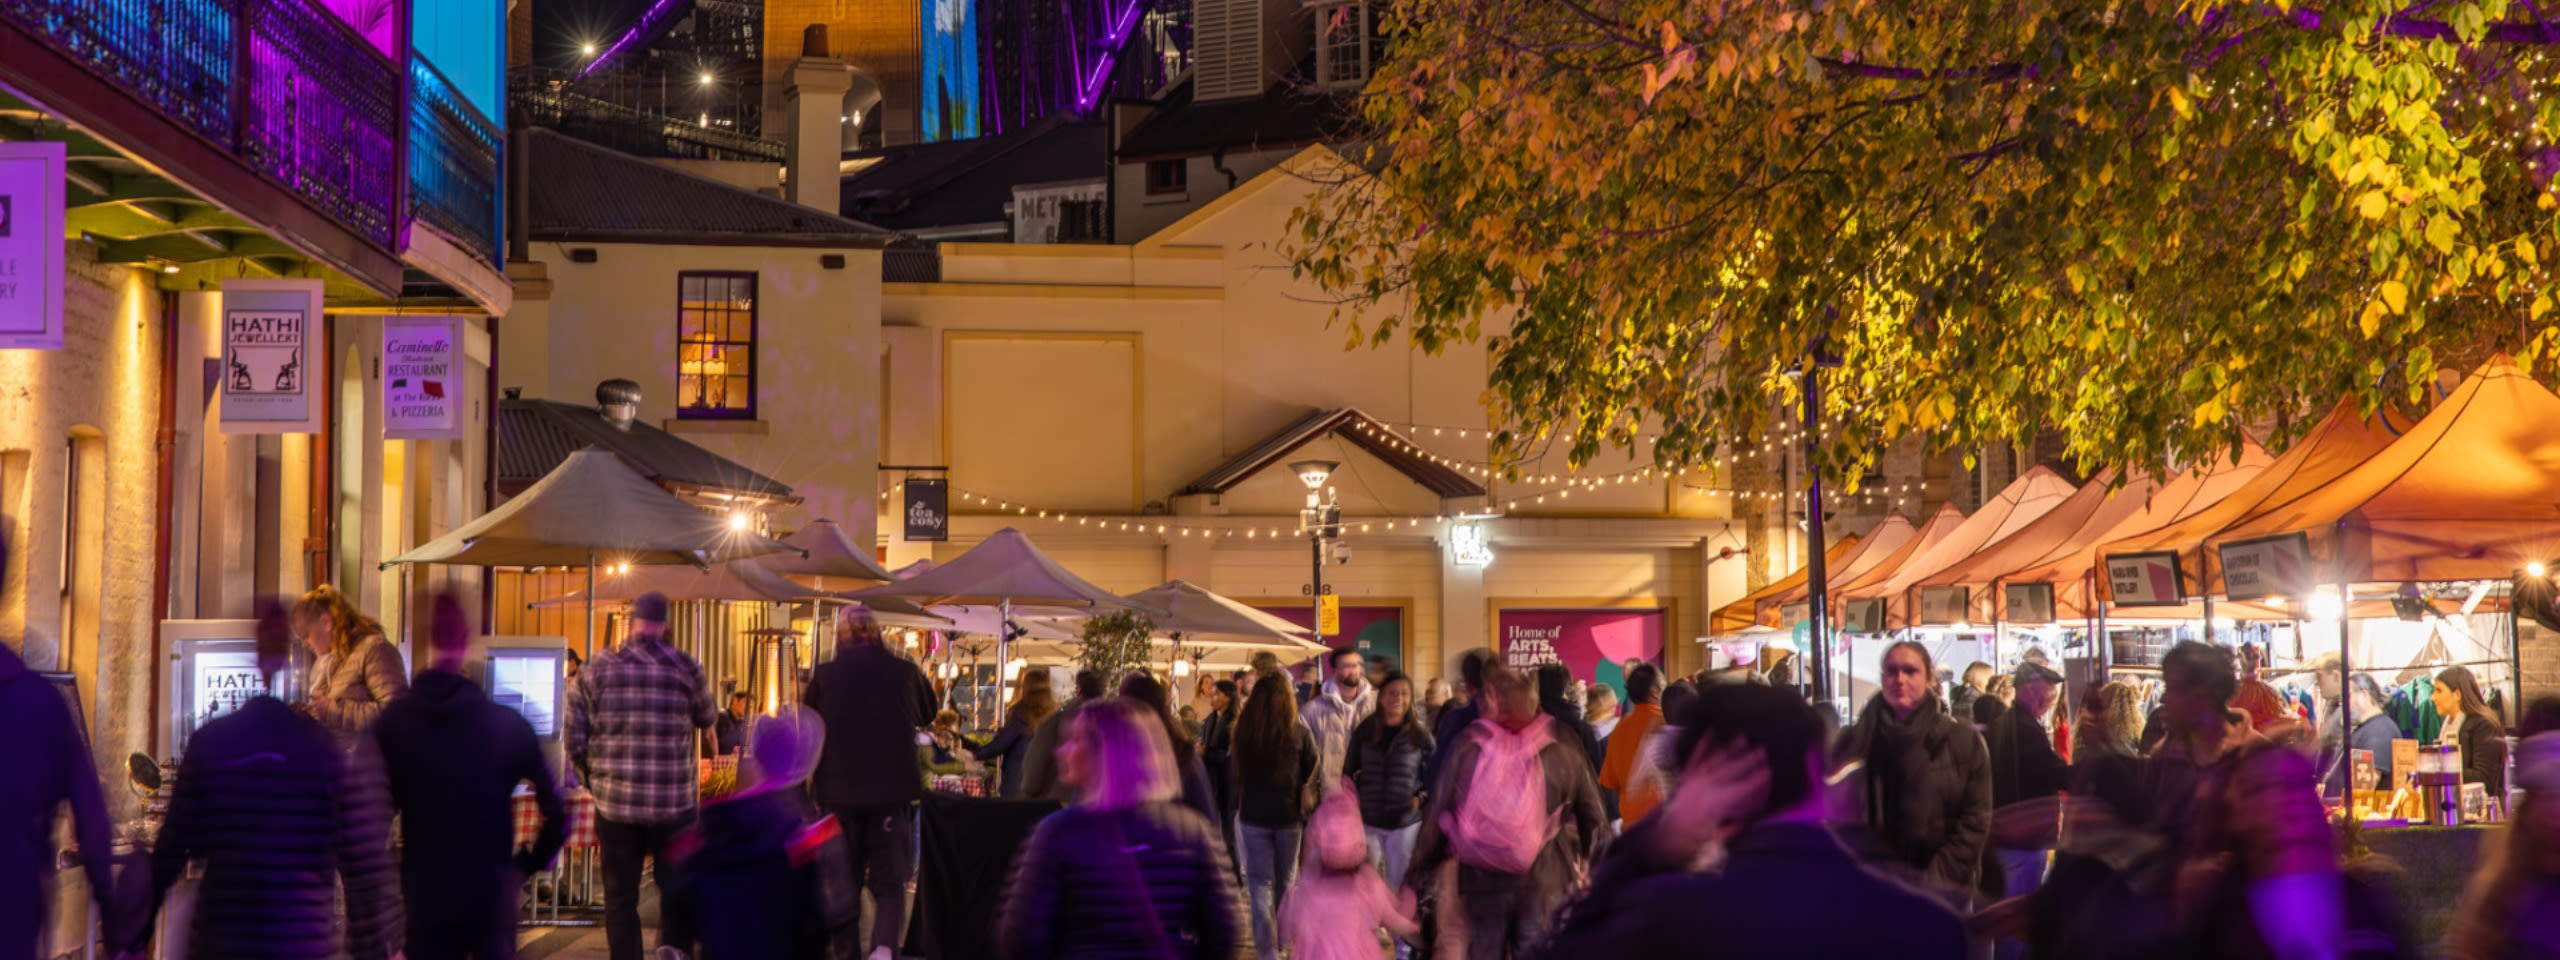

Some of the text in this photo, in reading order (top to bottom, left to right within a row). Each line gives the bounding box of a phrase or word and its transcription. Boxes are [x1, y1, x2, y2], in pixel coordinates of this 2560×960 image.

[231, 317, 299, 332] HATHI
[388, 364, 448, 377] RESTAURANT
[402, 405, 445, 417] PIZZERIA
[910, 507, 933, 518] tea
[910, 515, 944, 529] cosy
[1509, 625, 1562, 639] Home of
[1508, 639, 1554, 654] ARTS,
[1508, 652, 1563, 667] BEATS,
[207, 673, 265, 689] HATH
